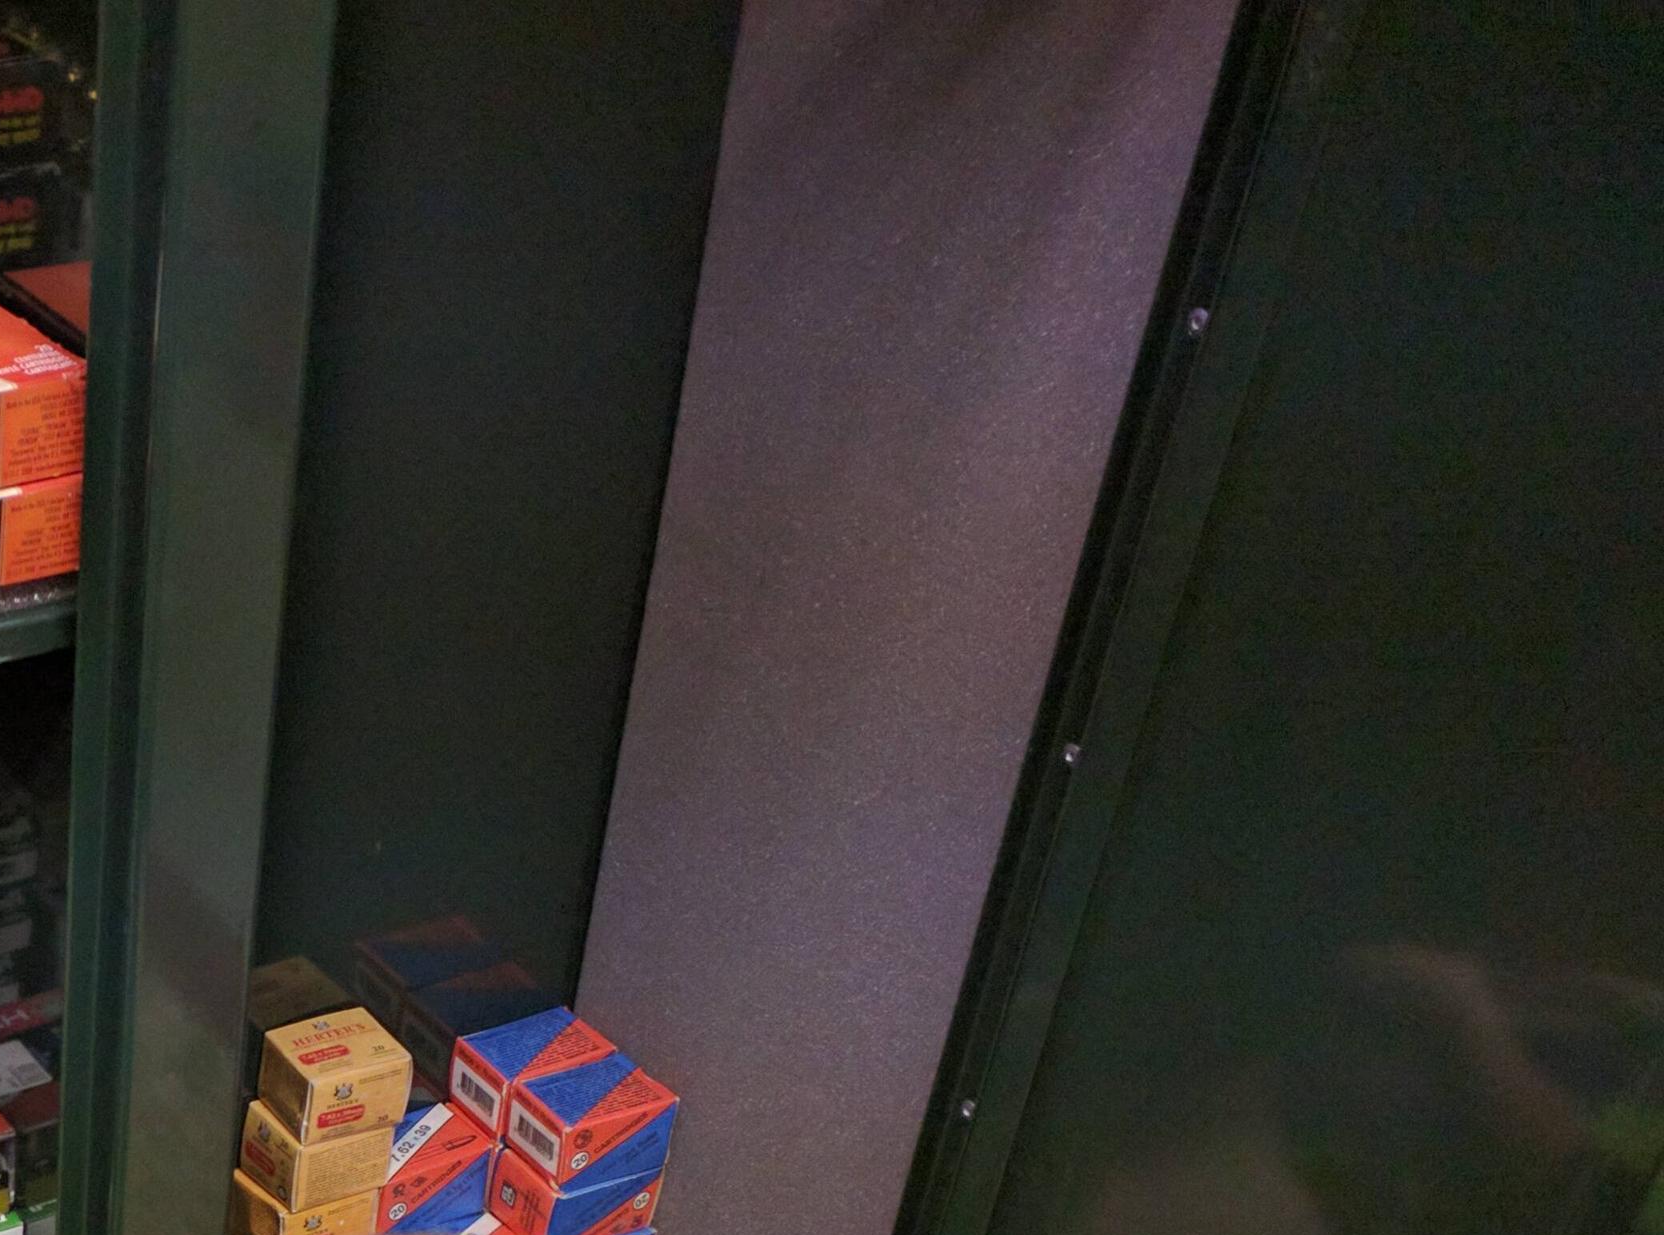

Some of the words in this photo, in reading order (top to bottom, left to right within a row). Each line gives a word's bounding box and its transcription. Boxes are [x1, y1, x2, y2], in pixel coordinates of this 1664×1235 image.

[414, 1124, 432, 1137] 39
[573, 1154, 588, 1168] 20
[390, 1204, 405, 1219] 20
